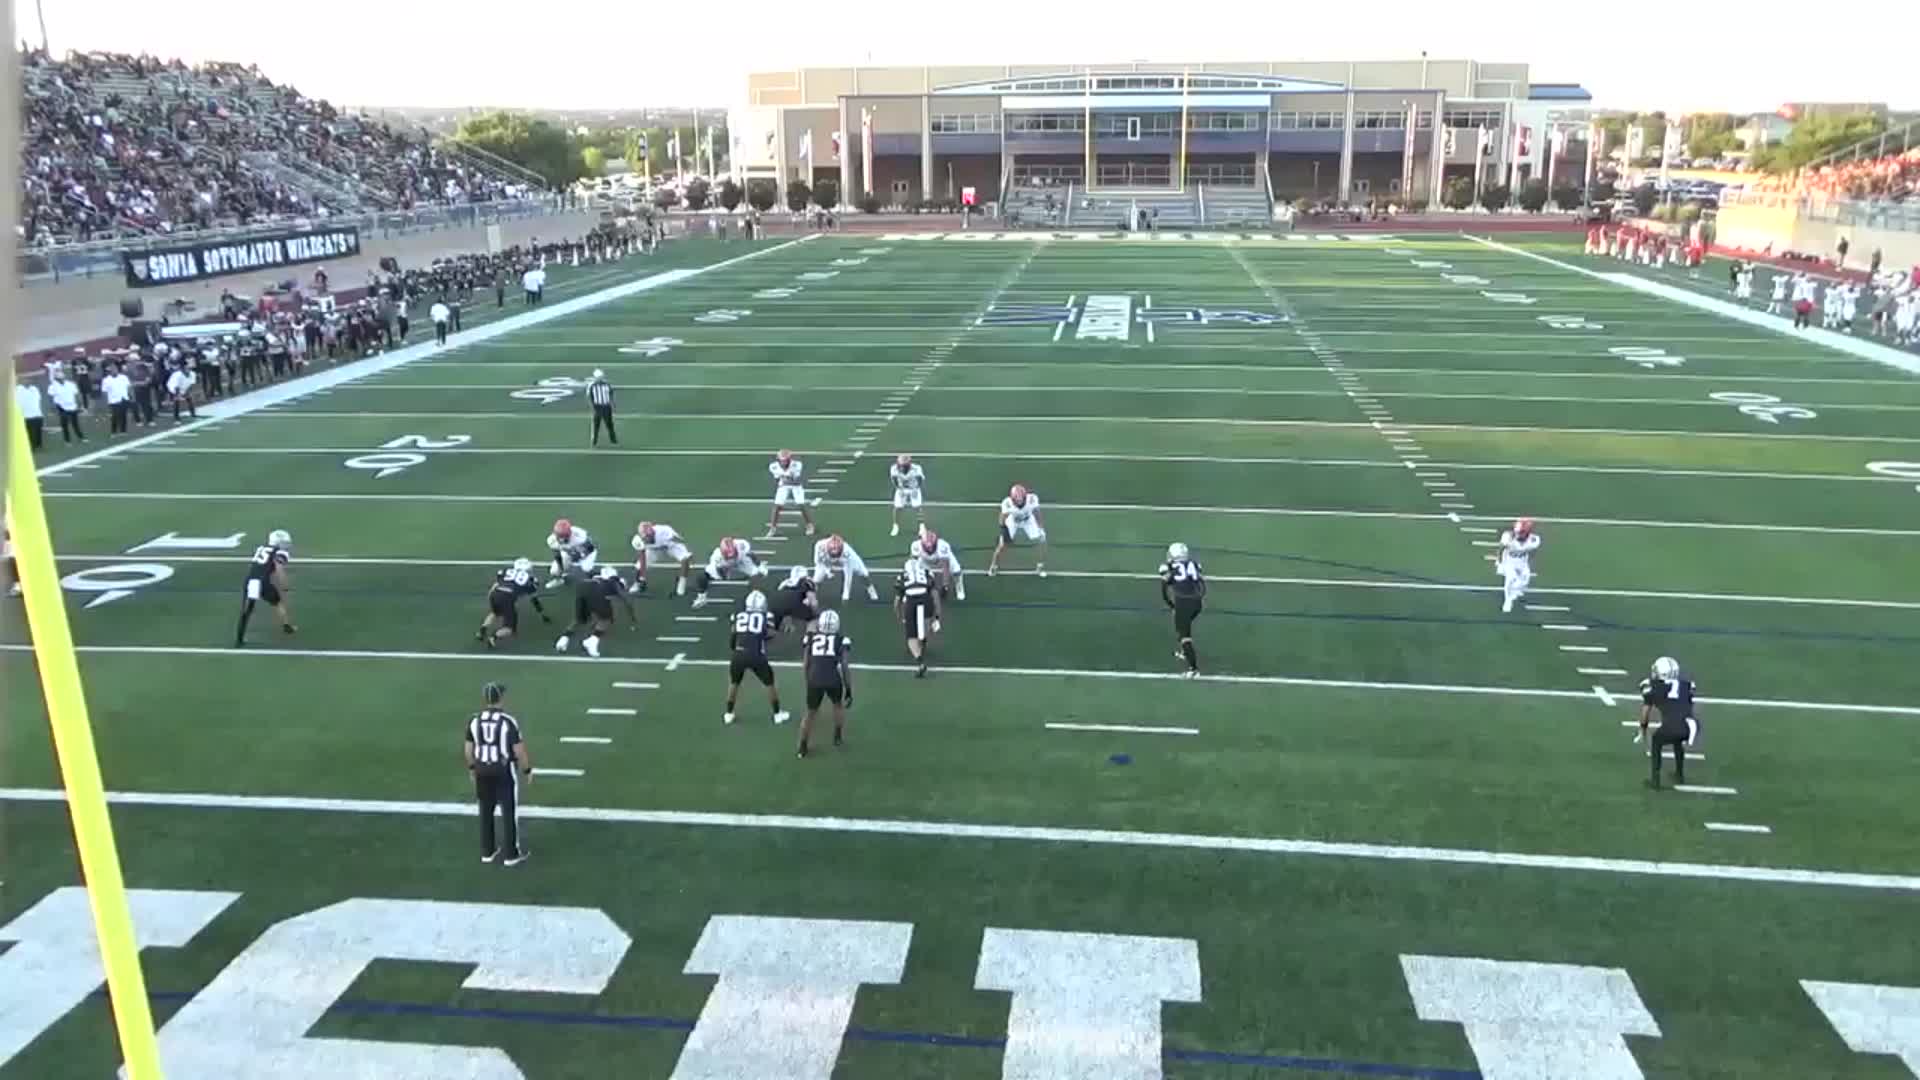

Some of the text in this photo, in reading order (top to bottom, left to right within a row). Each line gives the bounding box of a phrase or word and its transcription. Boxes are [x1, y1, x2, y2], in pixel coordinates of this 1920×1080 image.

[149, 233, 346, 280] SONIA SOTOMAYOR WILDCATS
[344, 434, 471, 468] 20
[60, 531, 247, 591] 10
[1173, 560, 1199, 582] 34
[735, 612, 763, 634] 20
[811, 635, 837, 657] 21
[1665, 680, 1680, 699] 7
[481, 723, 498, 743] U
